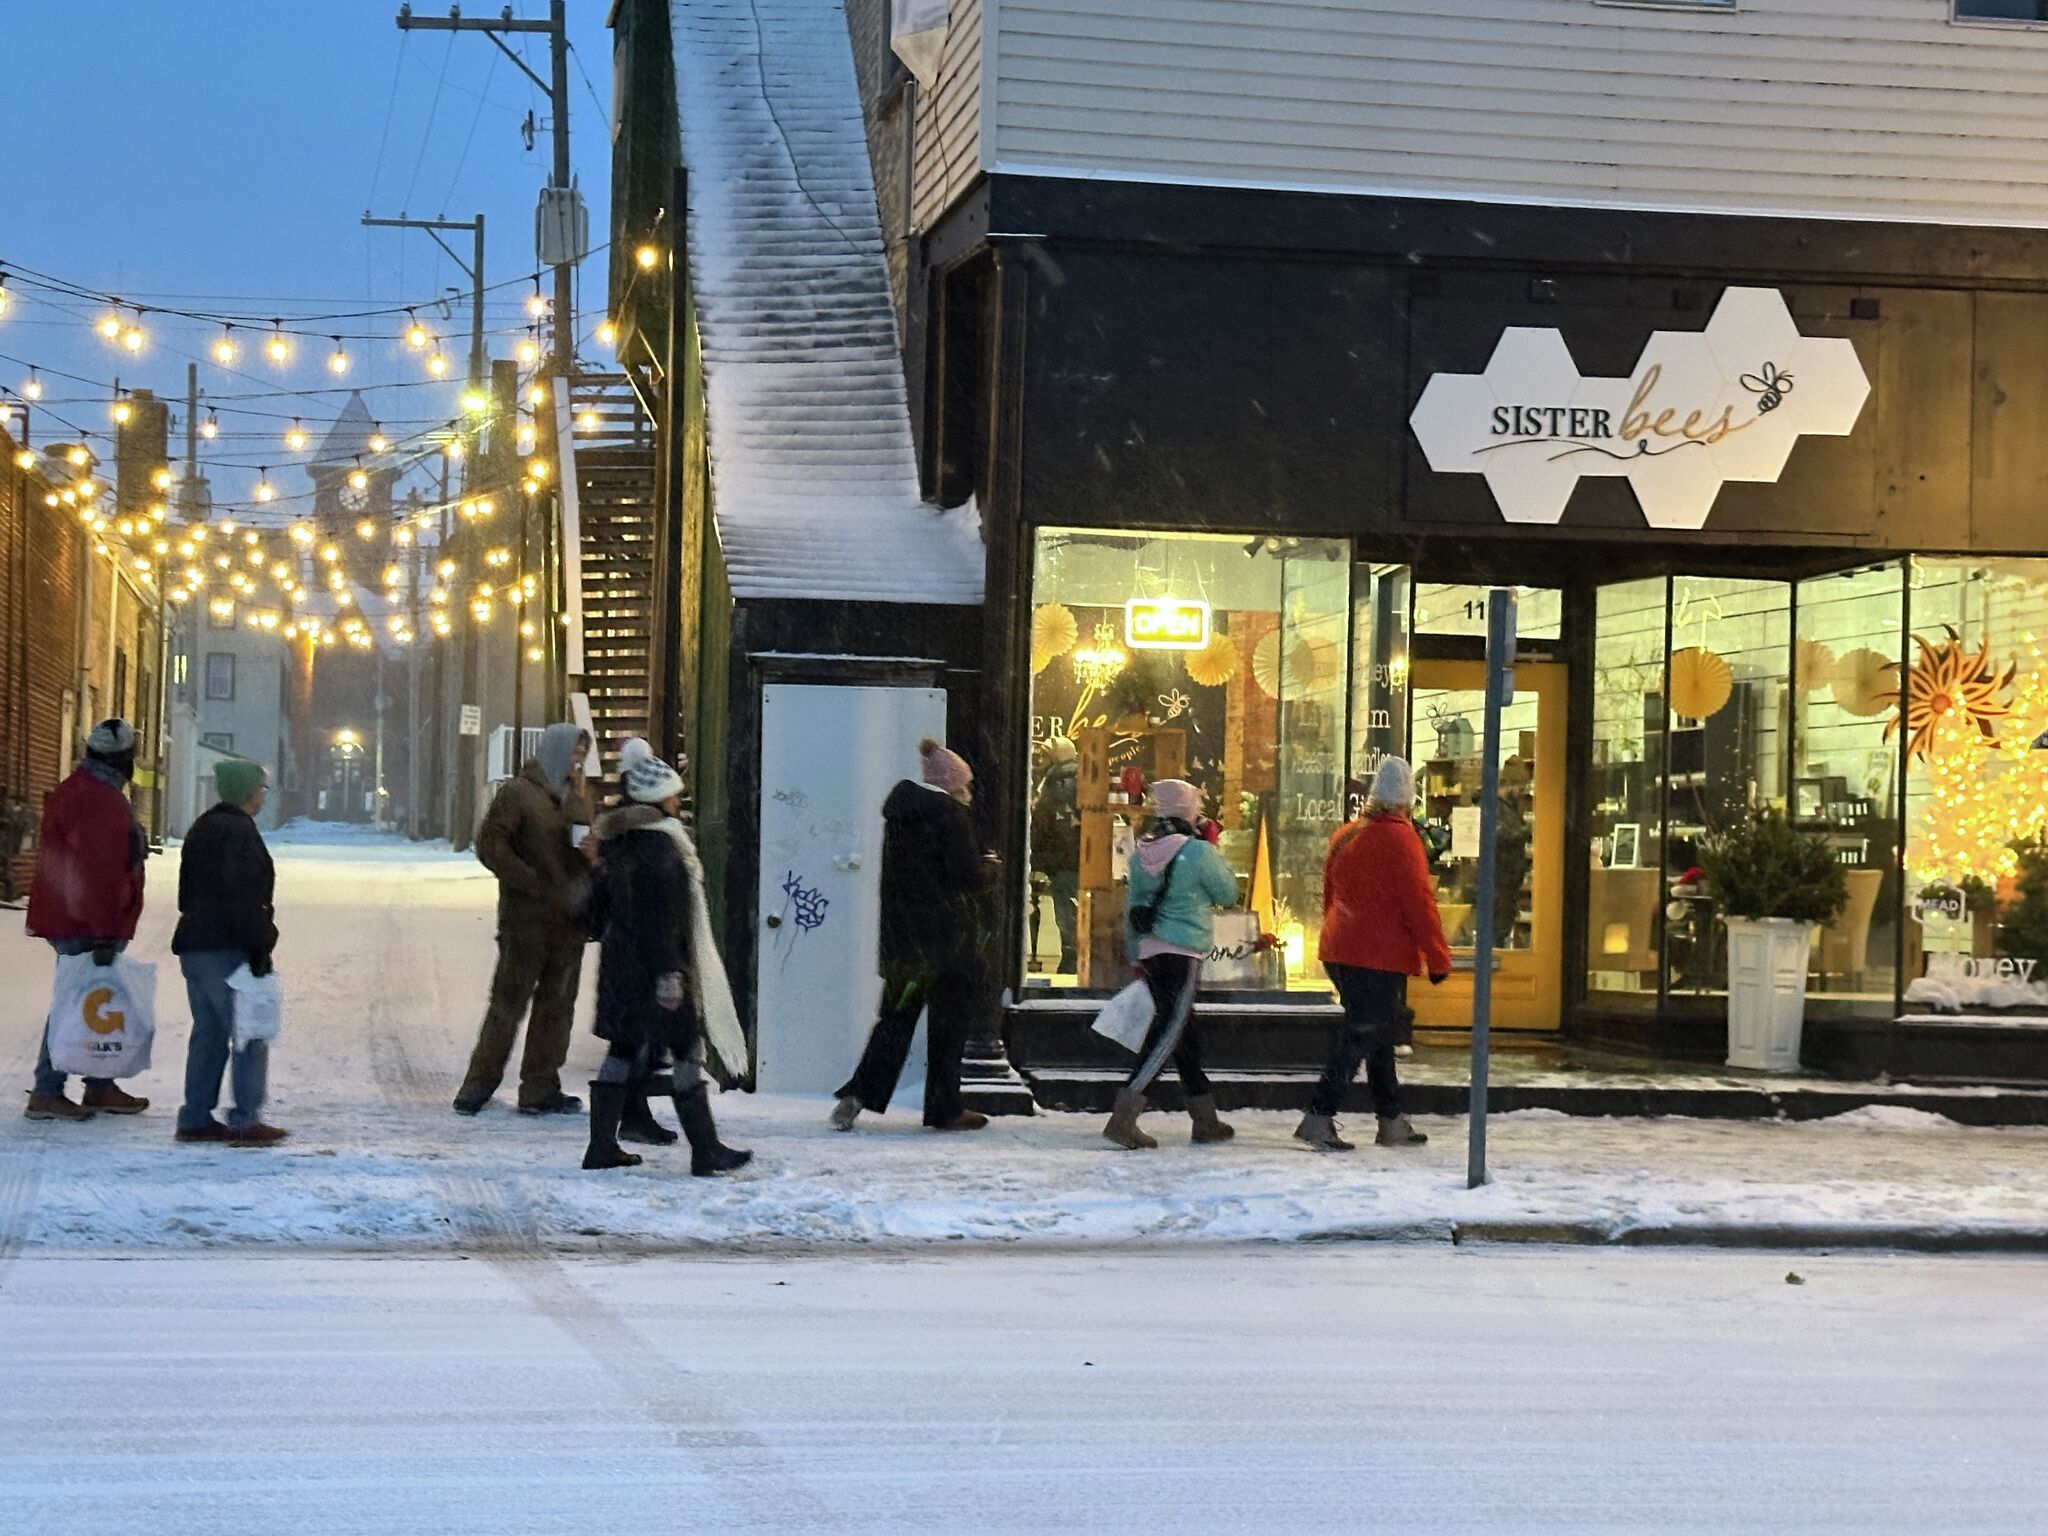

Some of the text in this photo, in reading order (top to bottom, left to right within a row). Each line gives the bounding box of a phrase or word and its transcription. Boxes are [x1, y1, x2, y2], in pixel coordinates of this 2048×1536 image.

[1491, 363, 1754, 444] SISTER bees
[1135, 613, 1199, 635] OPEN
[1296, 793, 1344, 821] Local
[83, 987, 126, 1035] G
